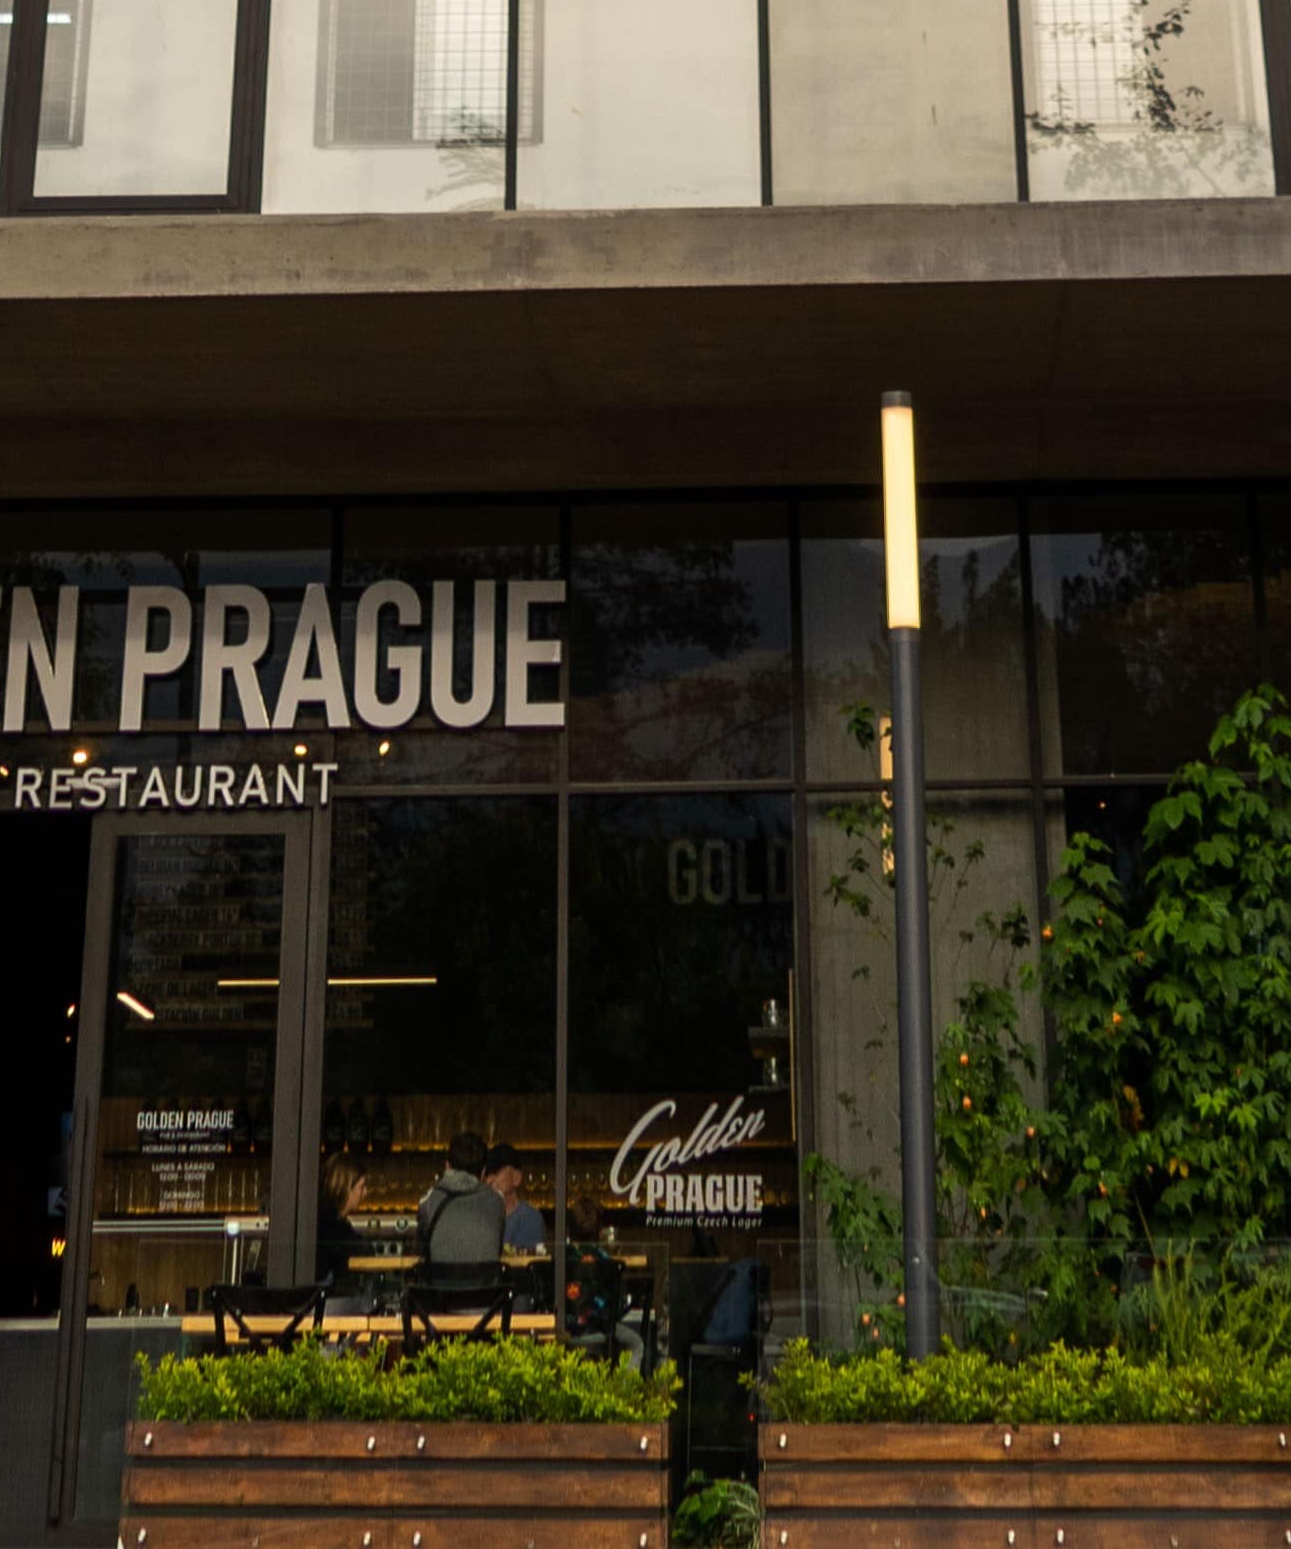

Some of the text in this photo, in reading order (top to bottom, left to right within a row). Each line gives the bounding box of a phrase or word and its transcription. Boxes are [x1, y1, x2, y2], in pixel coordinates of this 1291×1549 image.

[118, 579, 567, 732] PRAGUE
[14, 763, 338, 809] RESTAURANT
[136, 1109, 235, 1131] GOLDEN PRAGUE
[608, 1094, 766, 1205] Golden
[645, 1173, 764, 1214] PRAGUE
[645, 1215, 763, 1230] Premium Czech Lager
